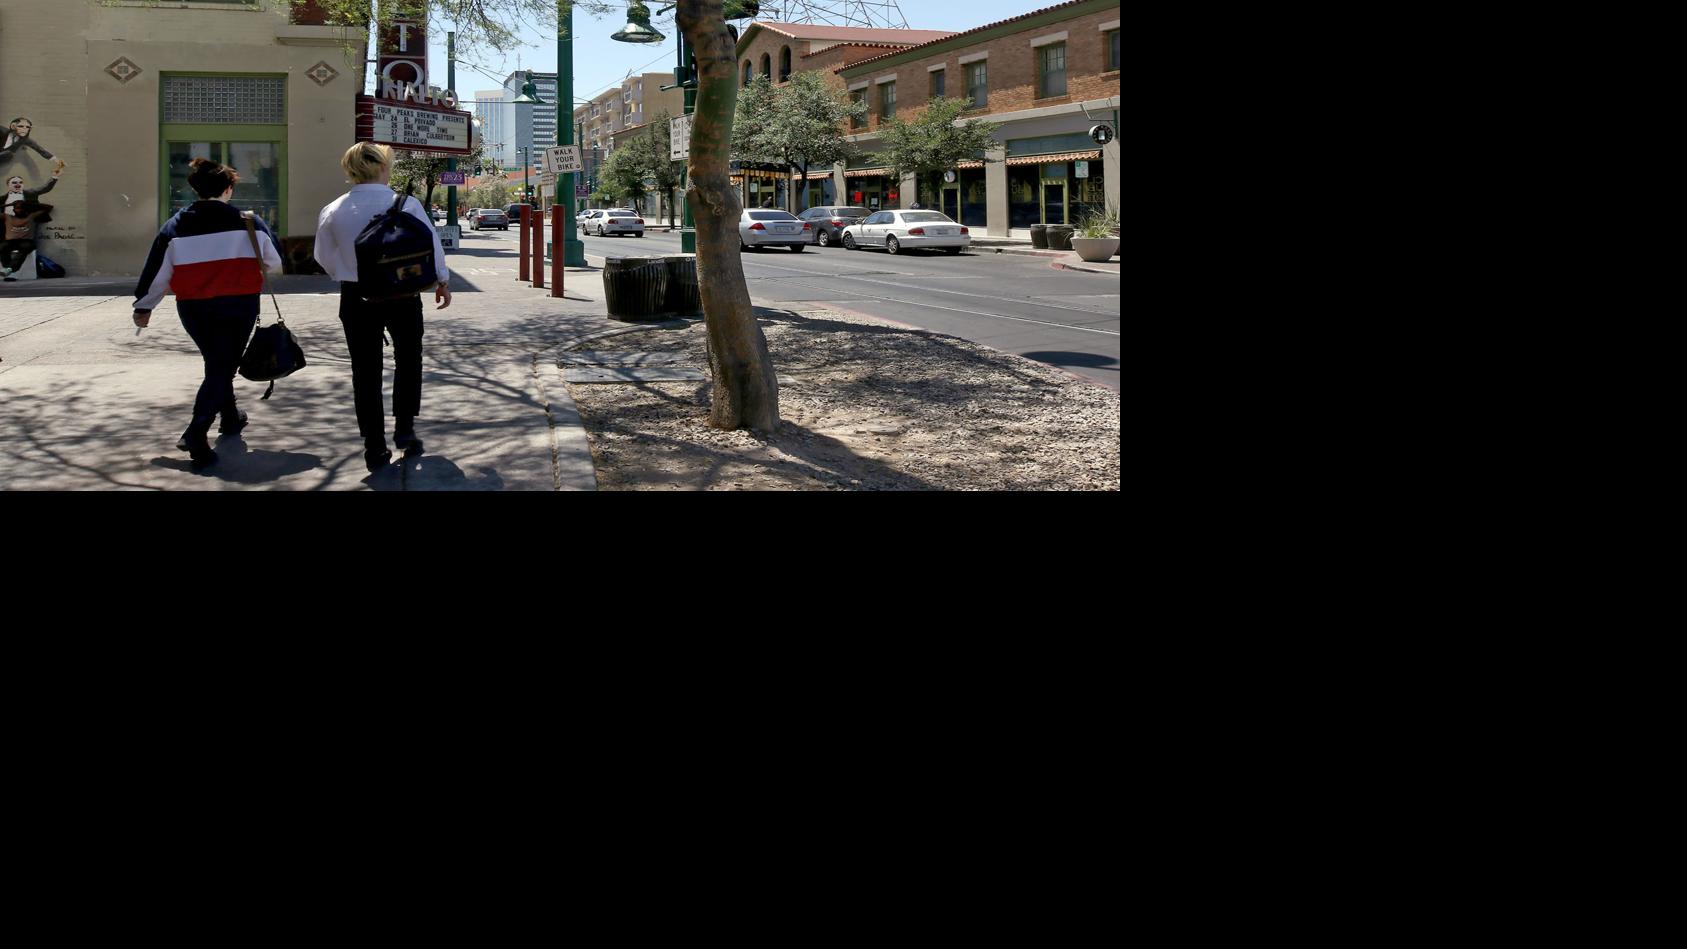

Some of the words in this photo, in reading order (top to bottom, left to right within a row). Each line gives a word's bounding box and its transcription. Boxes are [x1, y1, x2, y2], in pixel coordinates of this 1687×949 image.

[382, 79, 458, 108] RIALTO
[377, 106, 391, 114] FOUR
[397, 109, 414, 117] PEAKS
[417, 111, 438, 120] BREWING
[442, 115, 464, 124] PRESENTS
[414, 118, 436, 126] PRIVADO
[426, 132, 455, 141] CULBERTSON
